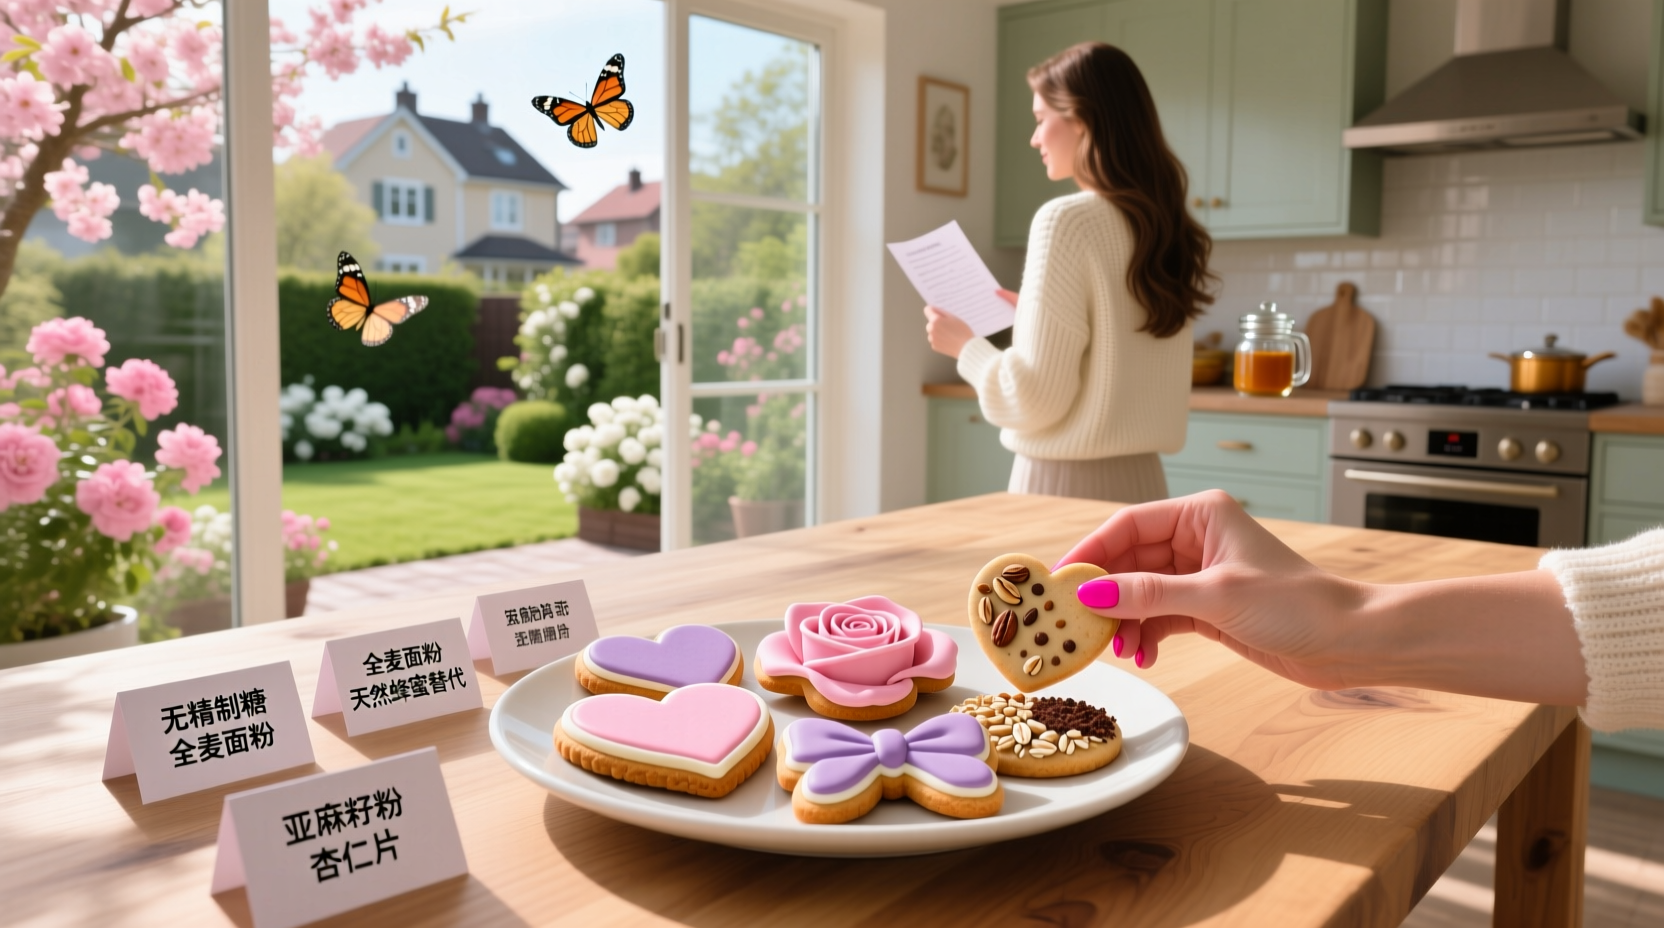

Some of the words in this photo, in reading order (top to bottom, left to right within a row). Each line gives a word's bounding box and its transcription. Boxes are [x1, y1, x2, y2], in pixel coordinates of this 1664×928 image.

[363, 641, 442, 676] 全麦面粉
[161, 688, 267, 735] 无精制糖
[350, 667, 467, 711] 天然蜂蜜替代
[169, 721, 275, 768] 全麦面粉
[282, 786, 402, 846] 亚麻籽粉
[310, 828, 399, 883] 杏仁片
